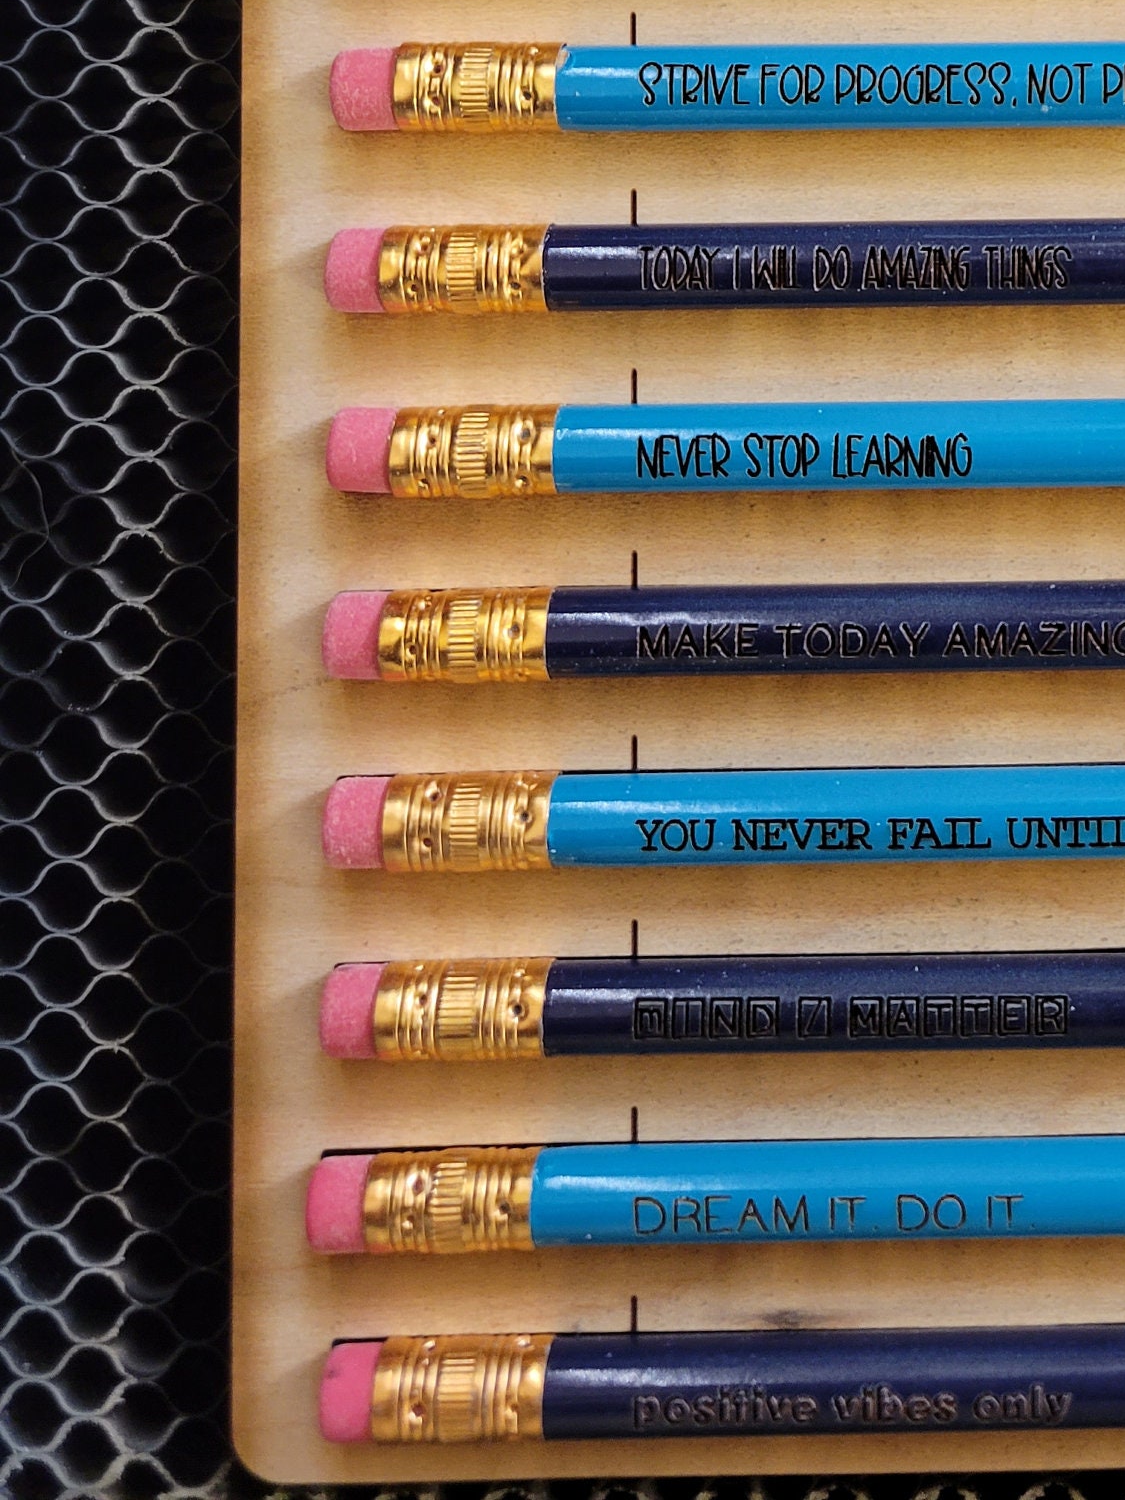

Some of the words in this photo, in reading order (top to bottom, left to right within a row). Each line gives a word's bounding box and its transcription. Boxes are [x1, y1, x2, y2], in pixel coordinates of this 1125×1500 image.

[638, 61, 751, 106] STRIVE
[757, 63, 824, 106] FOR
[834, 61, 1018, 109] PROGRESS,
[1026, 62, 1093, 105] NOT
[638, 245, 726, 290] TODAY
[731, 245, 742, 290] I
[750, 246, 800, 290] WILL
[812, 246, 850, 290] DO
[860, 246, 971, 289] AMAZING
[984, 245, 1072, 289] THINGS
[636, 435, 730, 479] NEVER
[742, 433, 820, 478] STOP
[832, 433, 973, 478] LEARNING
[636, 623, 760, 659] MAKE
[774, 622, 928, 658] TODAY
[635, 819, 716, 852] YOU
[731, 818, 873, 851] NEVER
[887, 817, 993, 850] FAIL
[848, 995, 1069, 1038] MATTER
[632, 1195, 810, 1236] DREAM
[895, 1194, 967, 1231] DO
[632, 1386, 818, 1429] positive
[829, 1382, 958, 1423] vibes
[971, 1382, 1074, 1423] only
